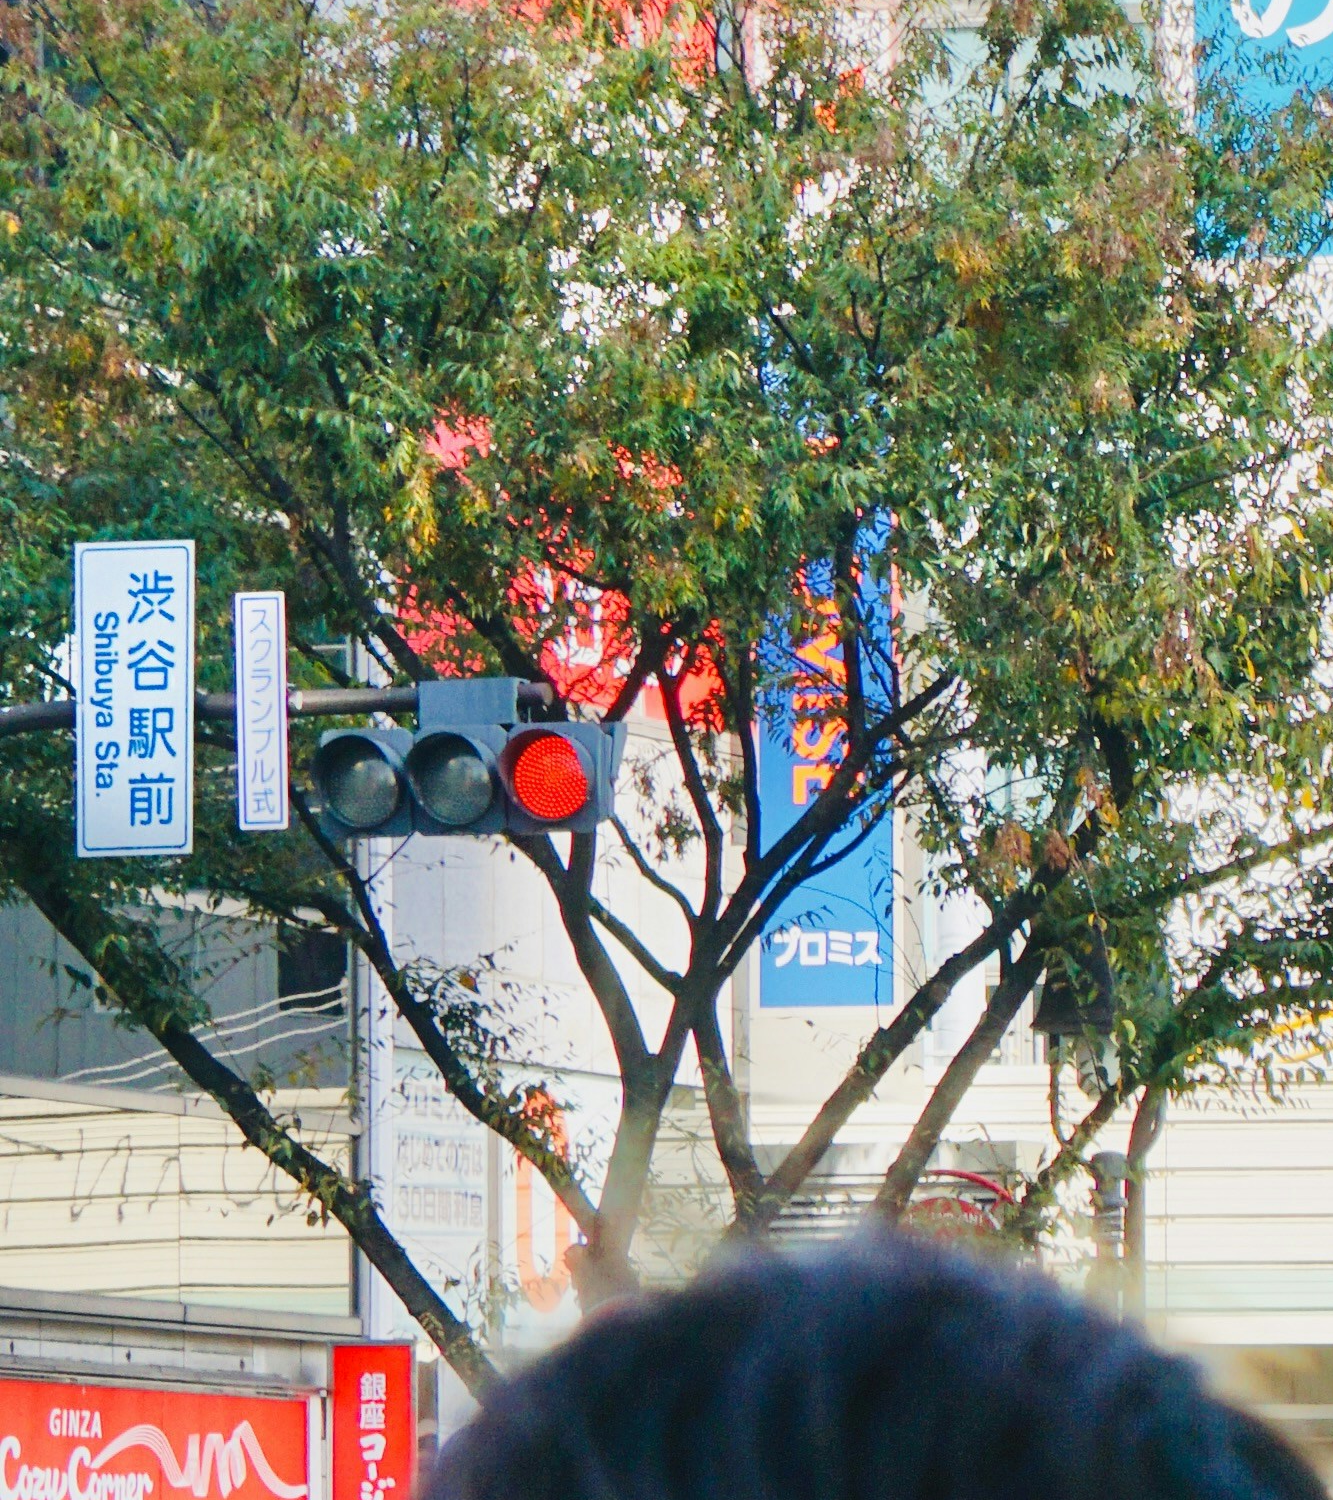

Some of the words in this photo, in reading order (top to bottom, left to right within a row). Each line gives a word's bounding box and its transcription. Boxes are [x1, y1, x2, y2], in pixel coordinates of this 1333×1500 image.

[90, 610, 120, 728] Shibuya
[126, 569, 177, 827] 渋谷駅前
[249, 608, 276, 816] スクランブル式
[95, 740, 120, 798] Sta.
[773, 928, 883, 968] プロミス
[49, 1407, 103, 1439] GINZA
